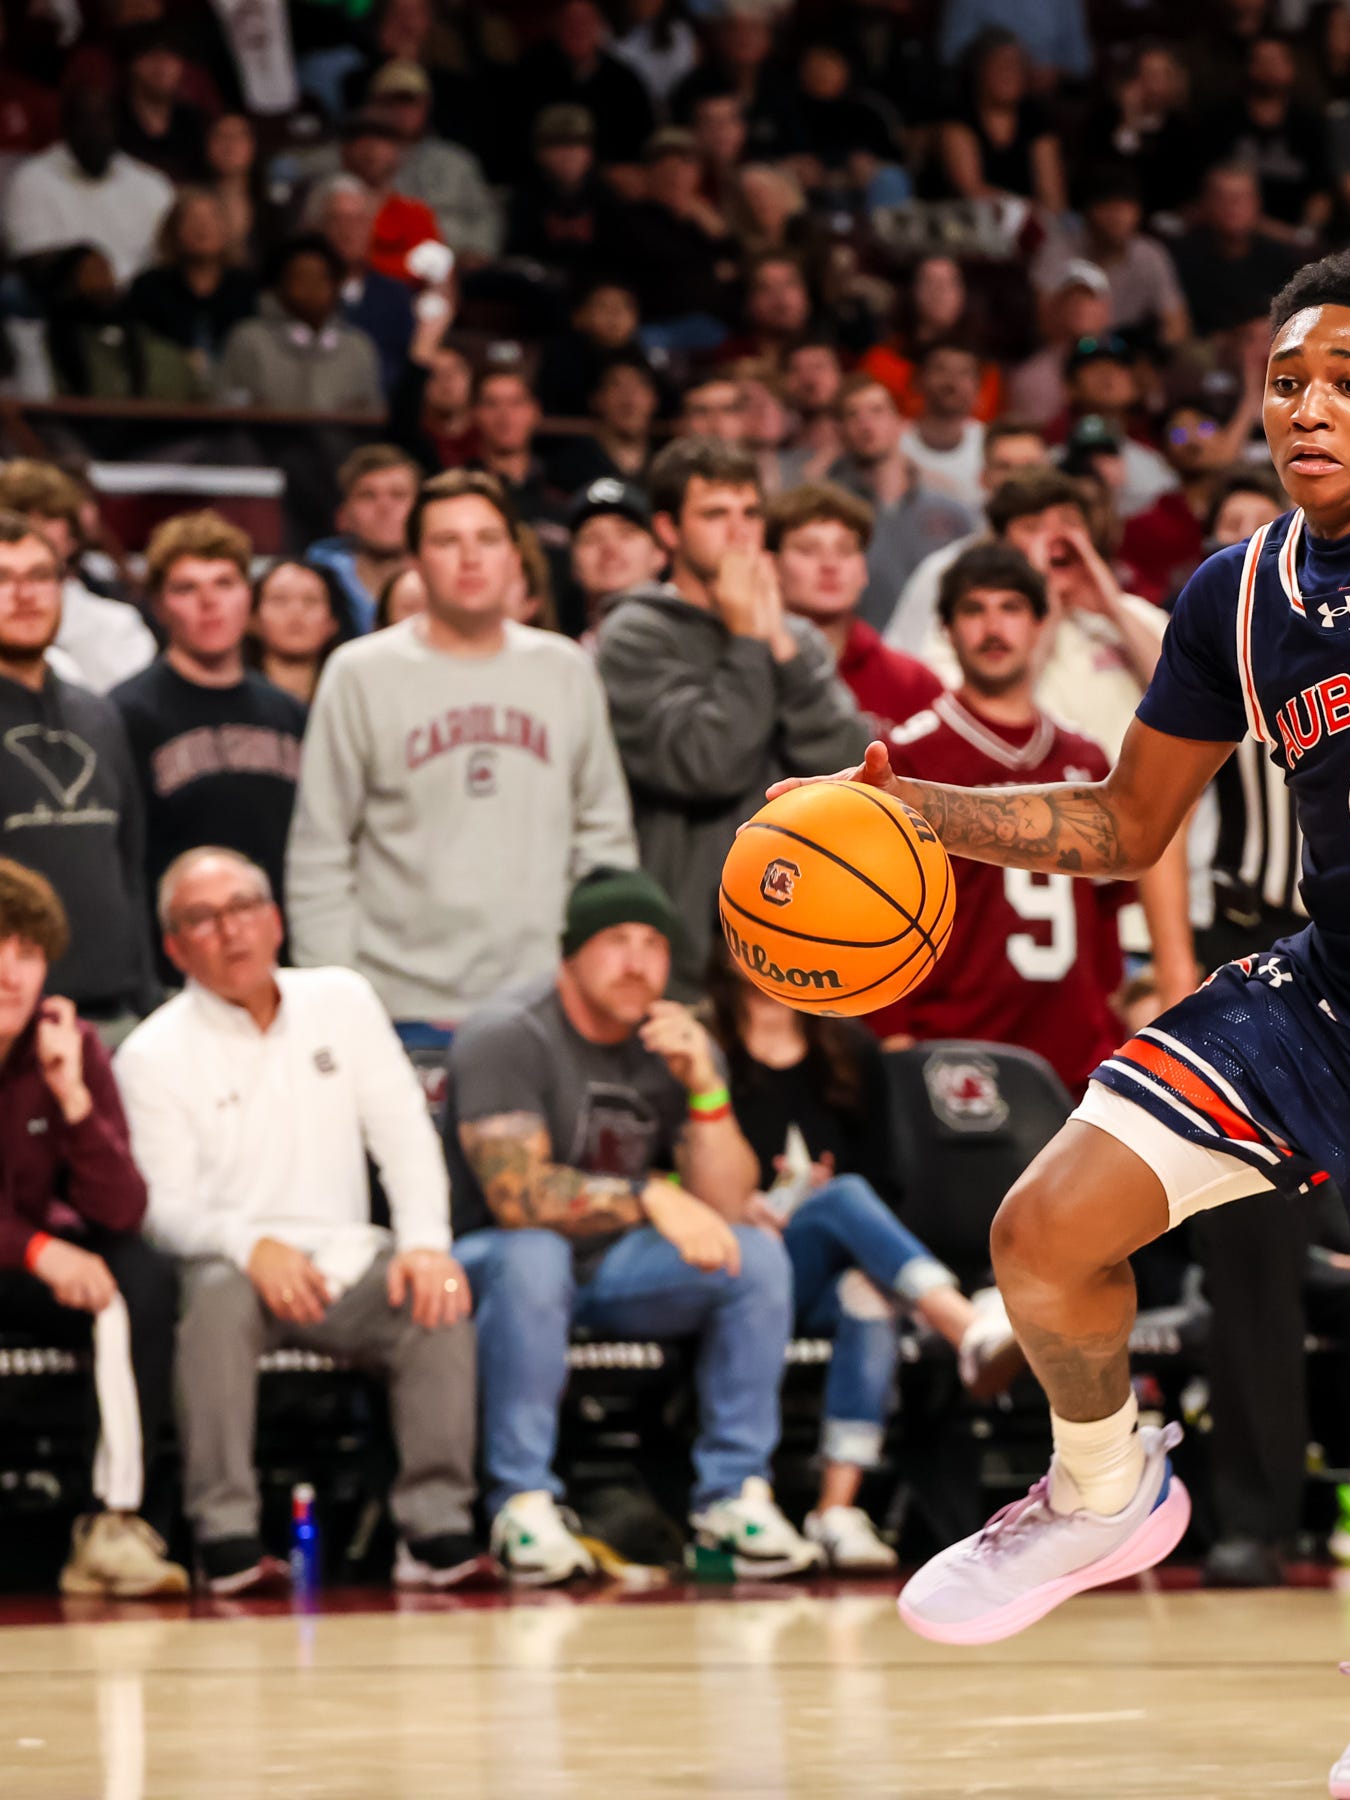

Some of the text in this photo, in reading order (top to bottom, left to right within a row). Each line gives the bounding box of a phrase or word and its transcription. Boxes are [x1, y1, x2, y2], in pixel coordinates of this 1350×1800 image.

[404, 702, 553, 772] CAROLINA
[720, 905, 843, 989] Wilson
[1003, 866, 1078, 982] 9
